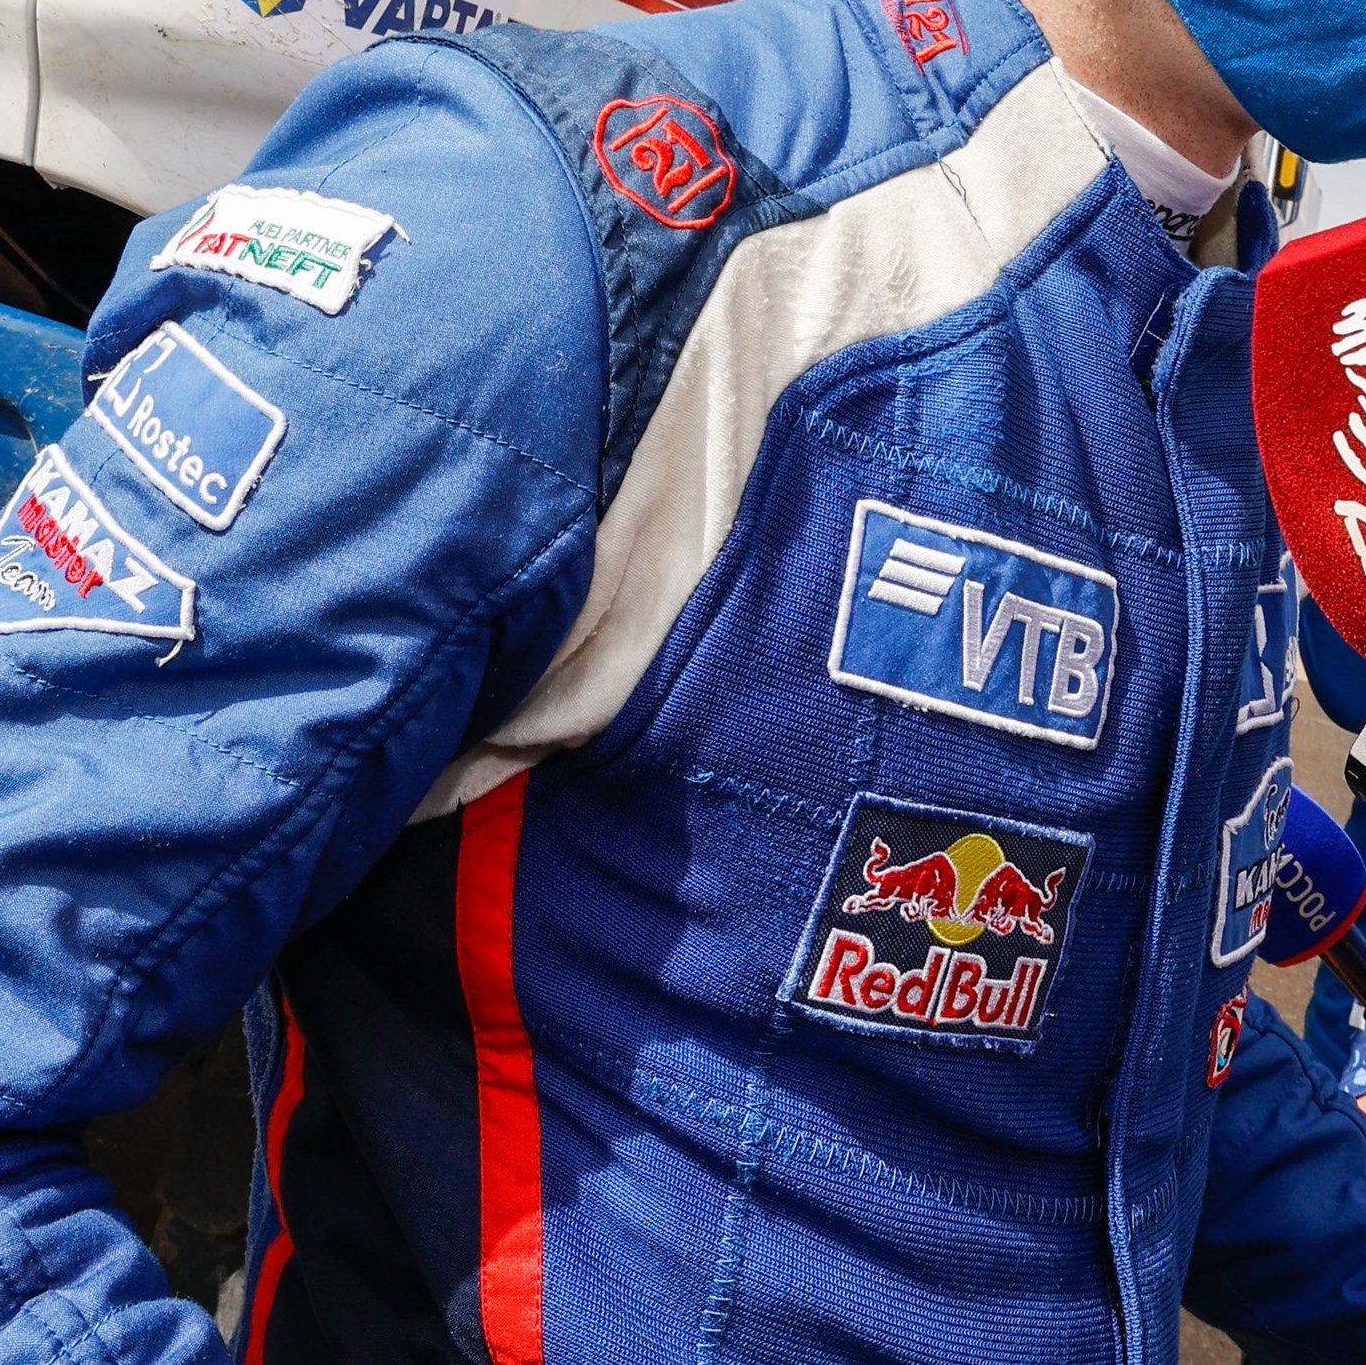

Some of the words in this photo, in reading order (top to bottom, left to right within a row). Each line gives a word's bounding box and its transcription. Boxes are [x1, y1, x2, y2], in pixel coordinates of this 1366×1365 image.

[193, 231, 343, 290] TATNEFT
[126, 394, 229, 506] Rostec
[17, 493, 104, 600] master
[25, 456, 160, 616] KAMAZ
[961, 579, 1105, 720] VTB
[808, 928, 947, 1026] Red
[937, 947, 1050, 1030] Bull
